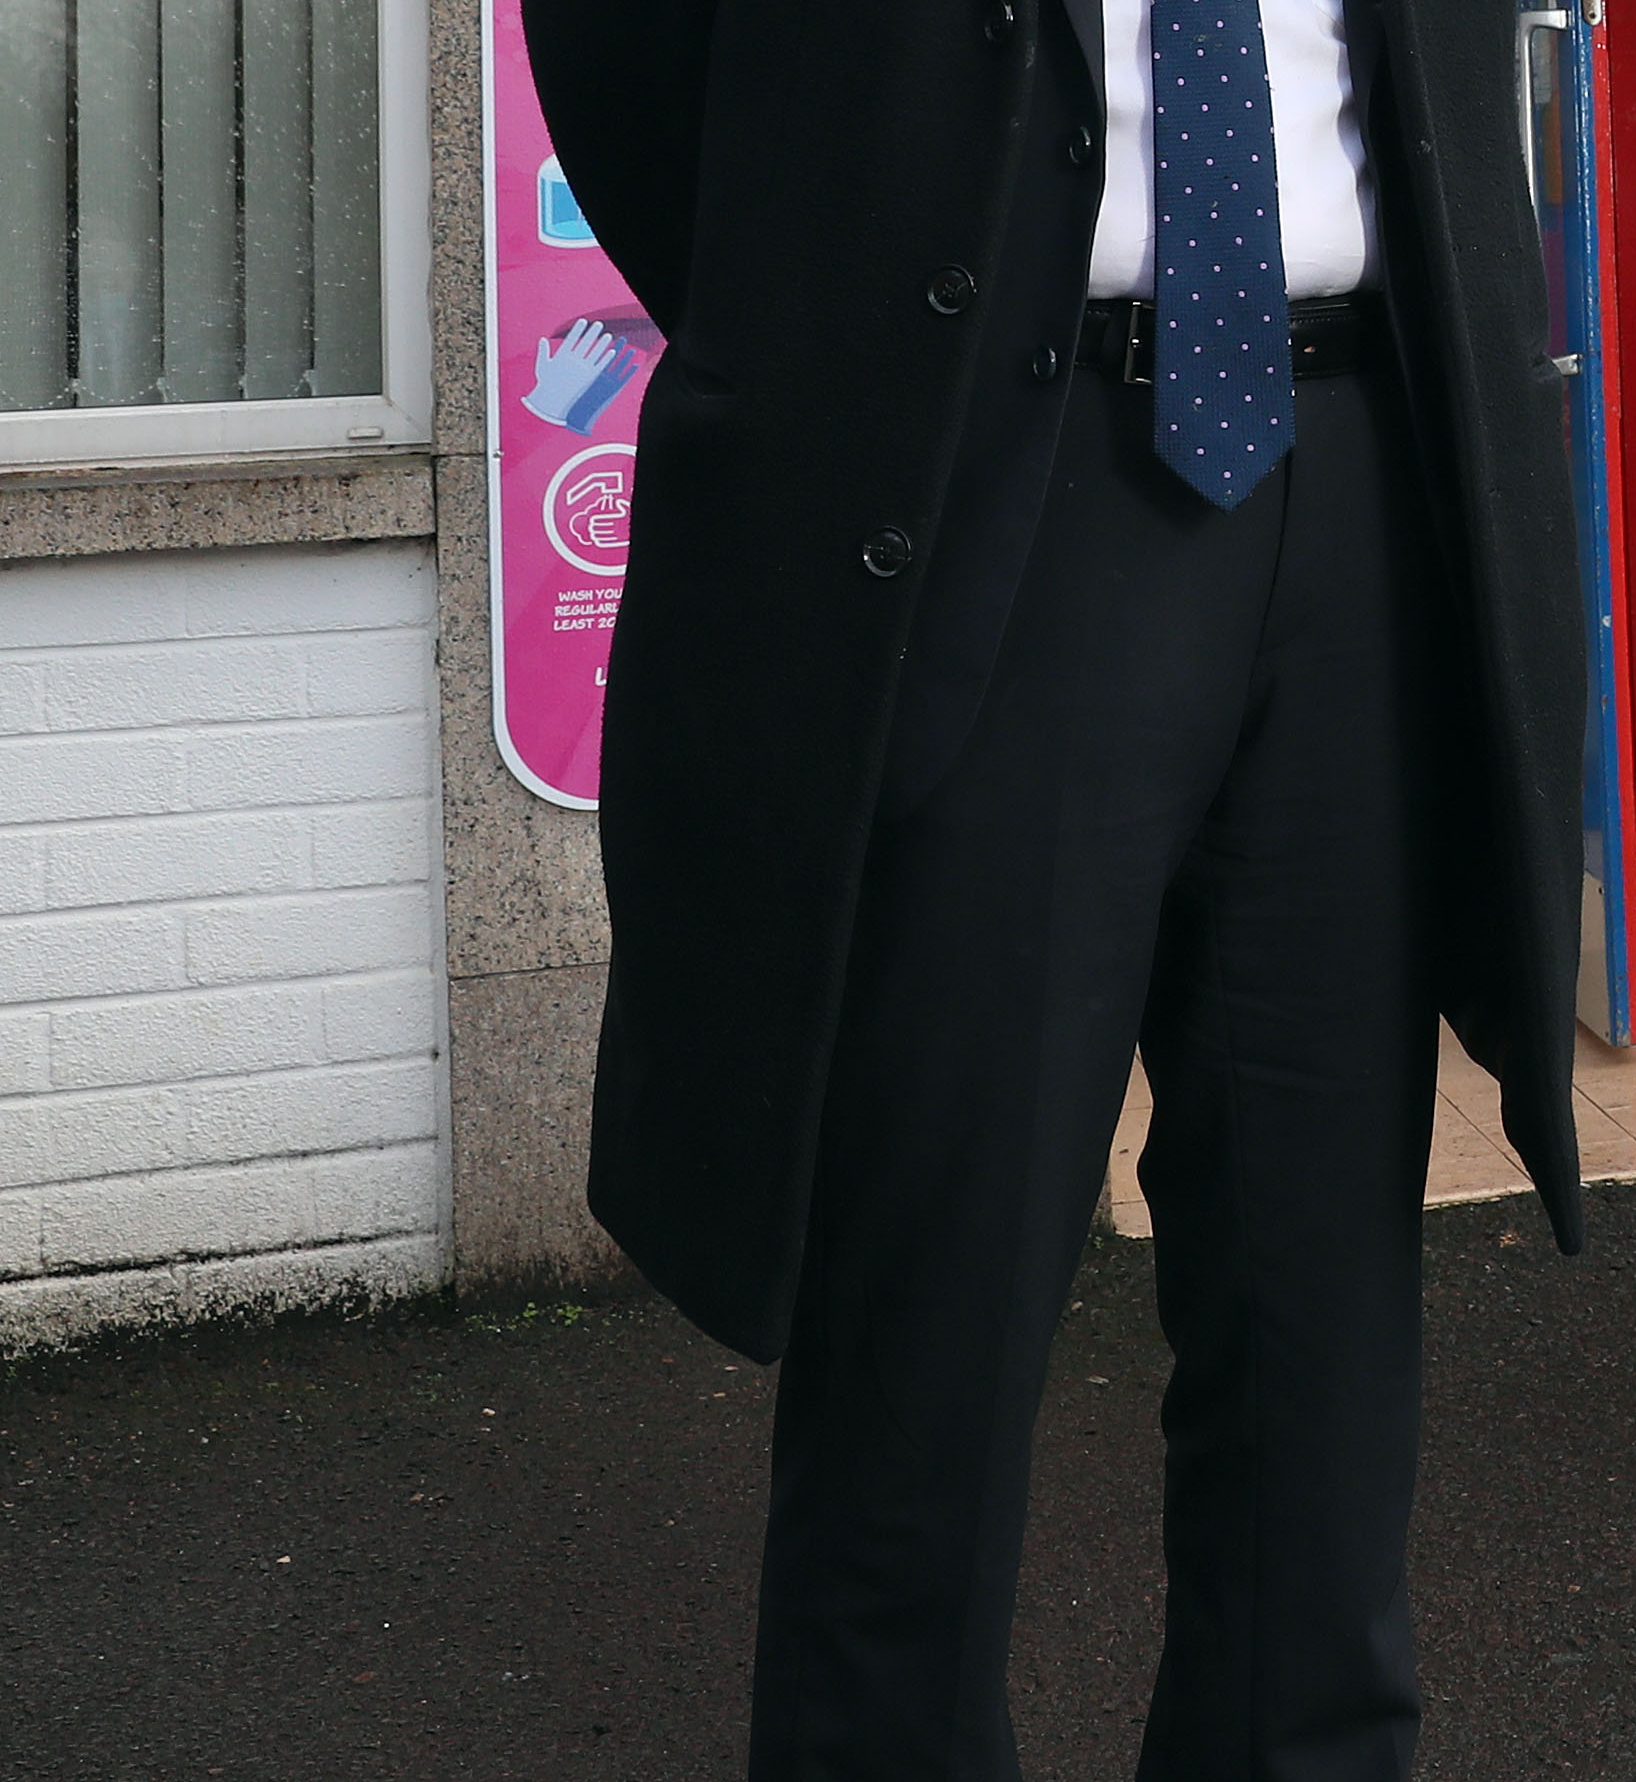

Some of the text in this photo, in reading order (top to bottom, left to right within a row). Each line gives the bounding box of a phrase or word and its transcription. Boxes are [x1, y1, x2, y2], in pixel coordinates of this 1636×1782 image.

[558, 588, 623, 602] WASH YOU
[554, 602, 619, 617] REGULARL
[553, 618, 594, 631] LEAST
